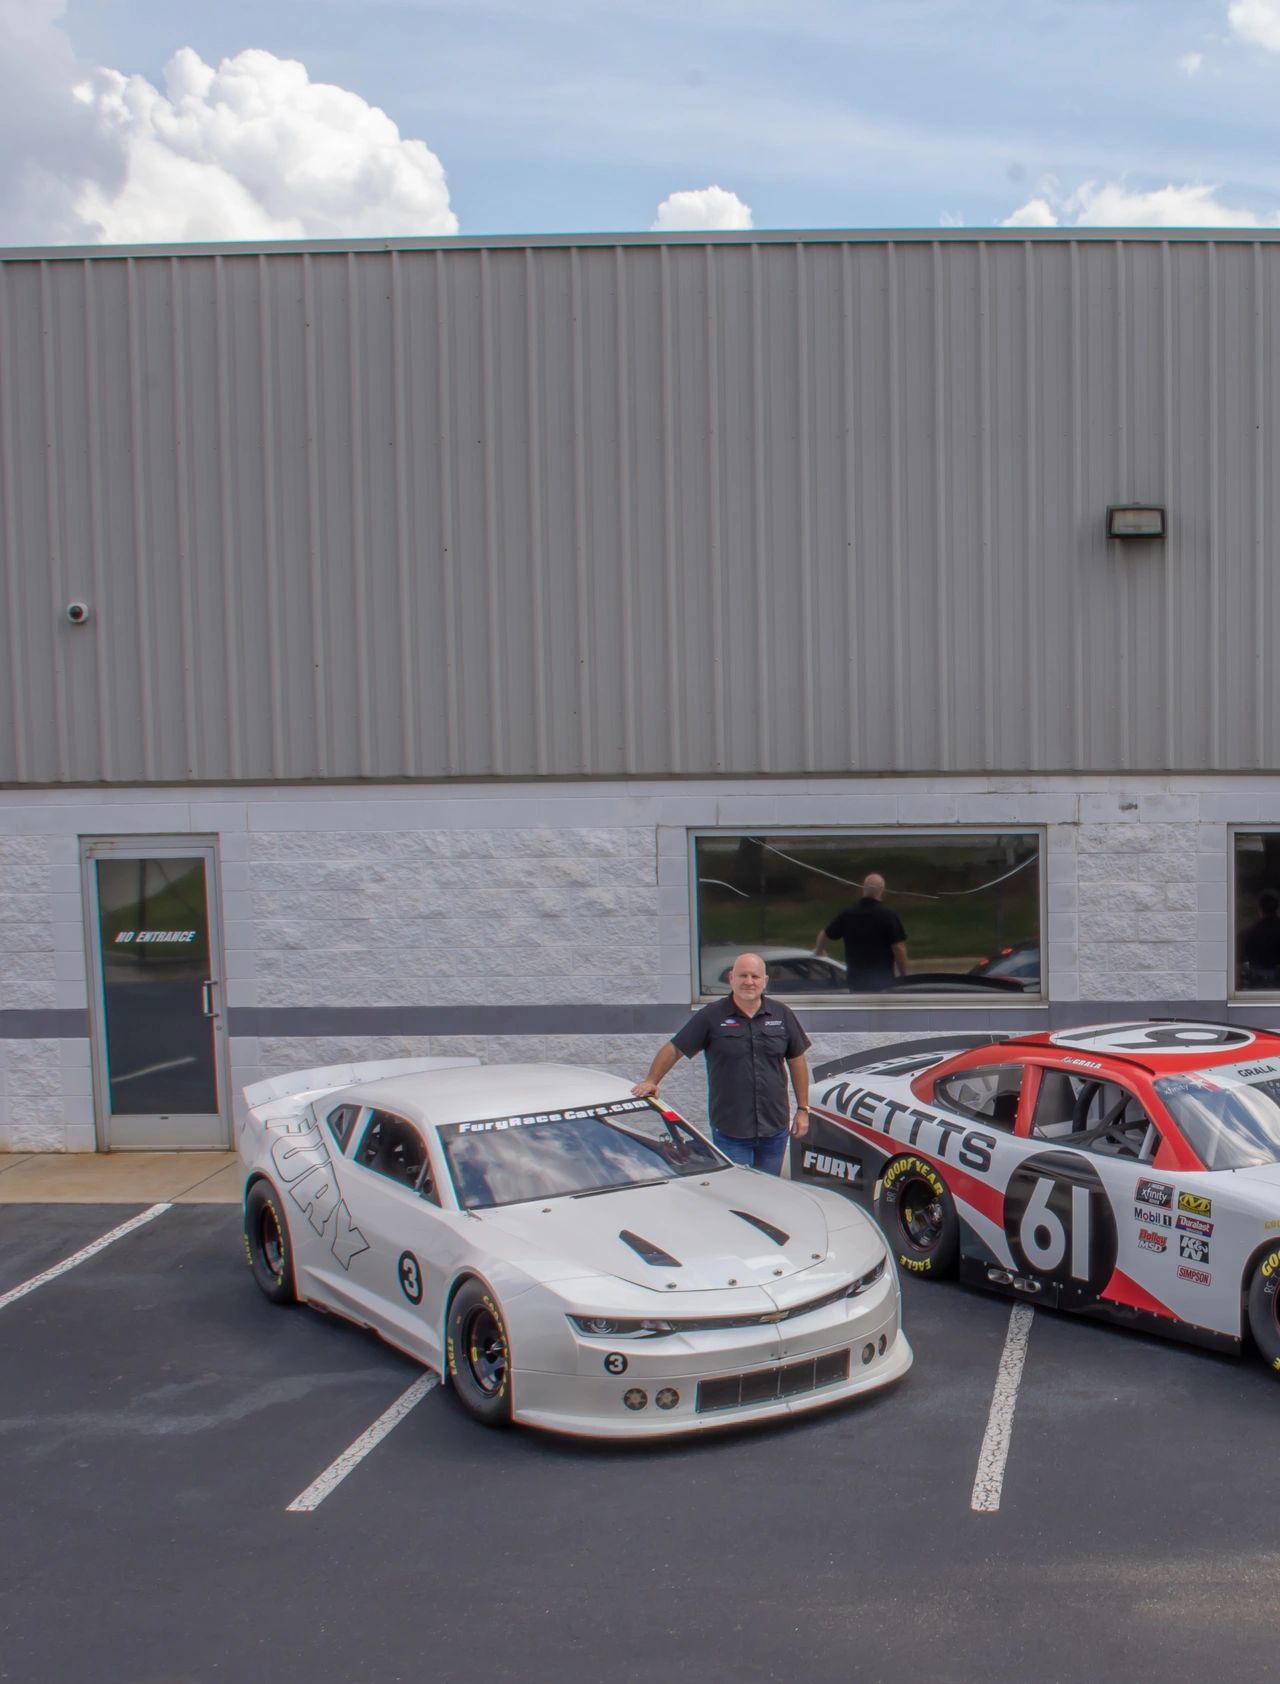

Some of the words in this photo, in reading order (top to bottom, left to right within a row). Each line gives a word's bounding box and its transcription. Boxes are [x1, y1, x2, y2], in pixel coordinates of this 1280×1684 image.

[115, 931, 135, 942] NO
[136, 931, 197, 943] ENTRANCE
[1237, 1064, 1277, 1079] GRALA
[458, 1099, 650, 1134] FuryRaceCars.com
[821, 1081, 997, 1173] NETTTS
[803, 1150, 861, 1182] FURY
[266, 1102, 371, 1272] FURY
[1141, 1187, 1168, 1204] xfinity
[1134, 1206, 1161, 1224] Mobil
[1020, 1176, 1091, 1281] 61
[1138, 1240, 1166, 1253] MSD
[900, 1255, 932, 1271] EAGLE
[403, 1256, 418, 1298] 3
[1179, 1267, 1209, 1284] SIMPSON
[607, 1353, 626, 1372] 3
